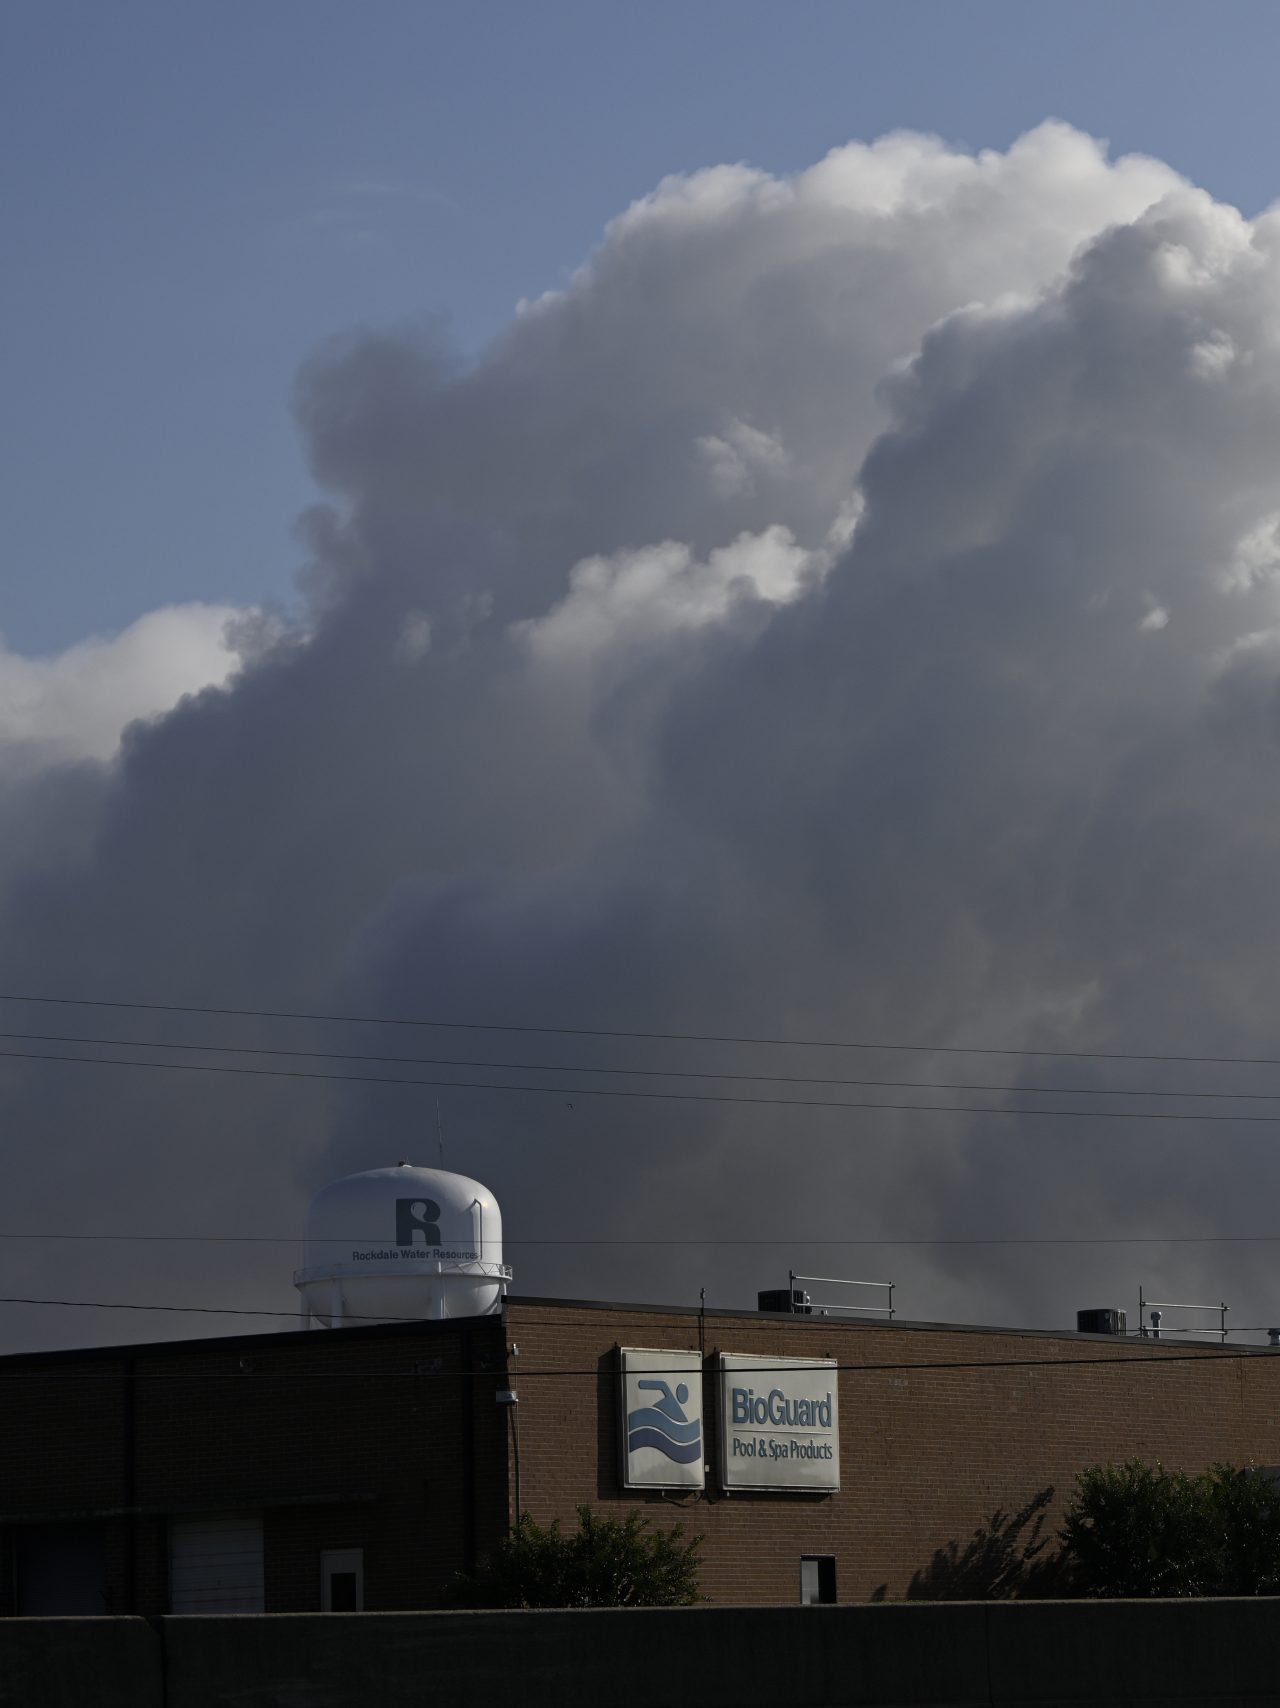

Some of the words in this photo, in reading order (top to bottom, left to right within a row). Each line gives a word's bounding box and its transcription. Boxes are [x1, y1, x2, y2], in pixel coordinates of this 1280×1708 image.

[396, 1199, 442, 1247] R
[352, 1249, 399, 1261] Rockdale
[401, 1249, 431, 1259] Water
[433, 1249, 479, 1260] Resources
[732, 1388, 832, 1427] BioGuard
[733, 1437, 756, 1457] Pool
[758, 1438, 767, 1458] &
[769, 1438, 788, 1461] Spa
[790, 1439, 832, 1459] Products
